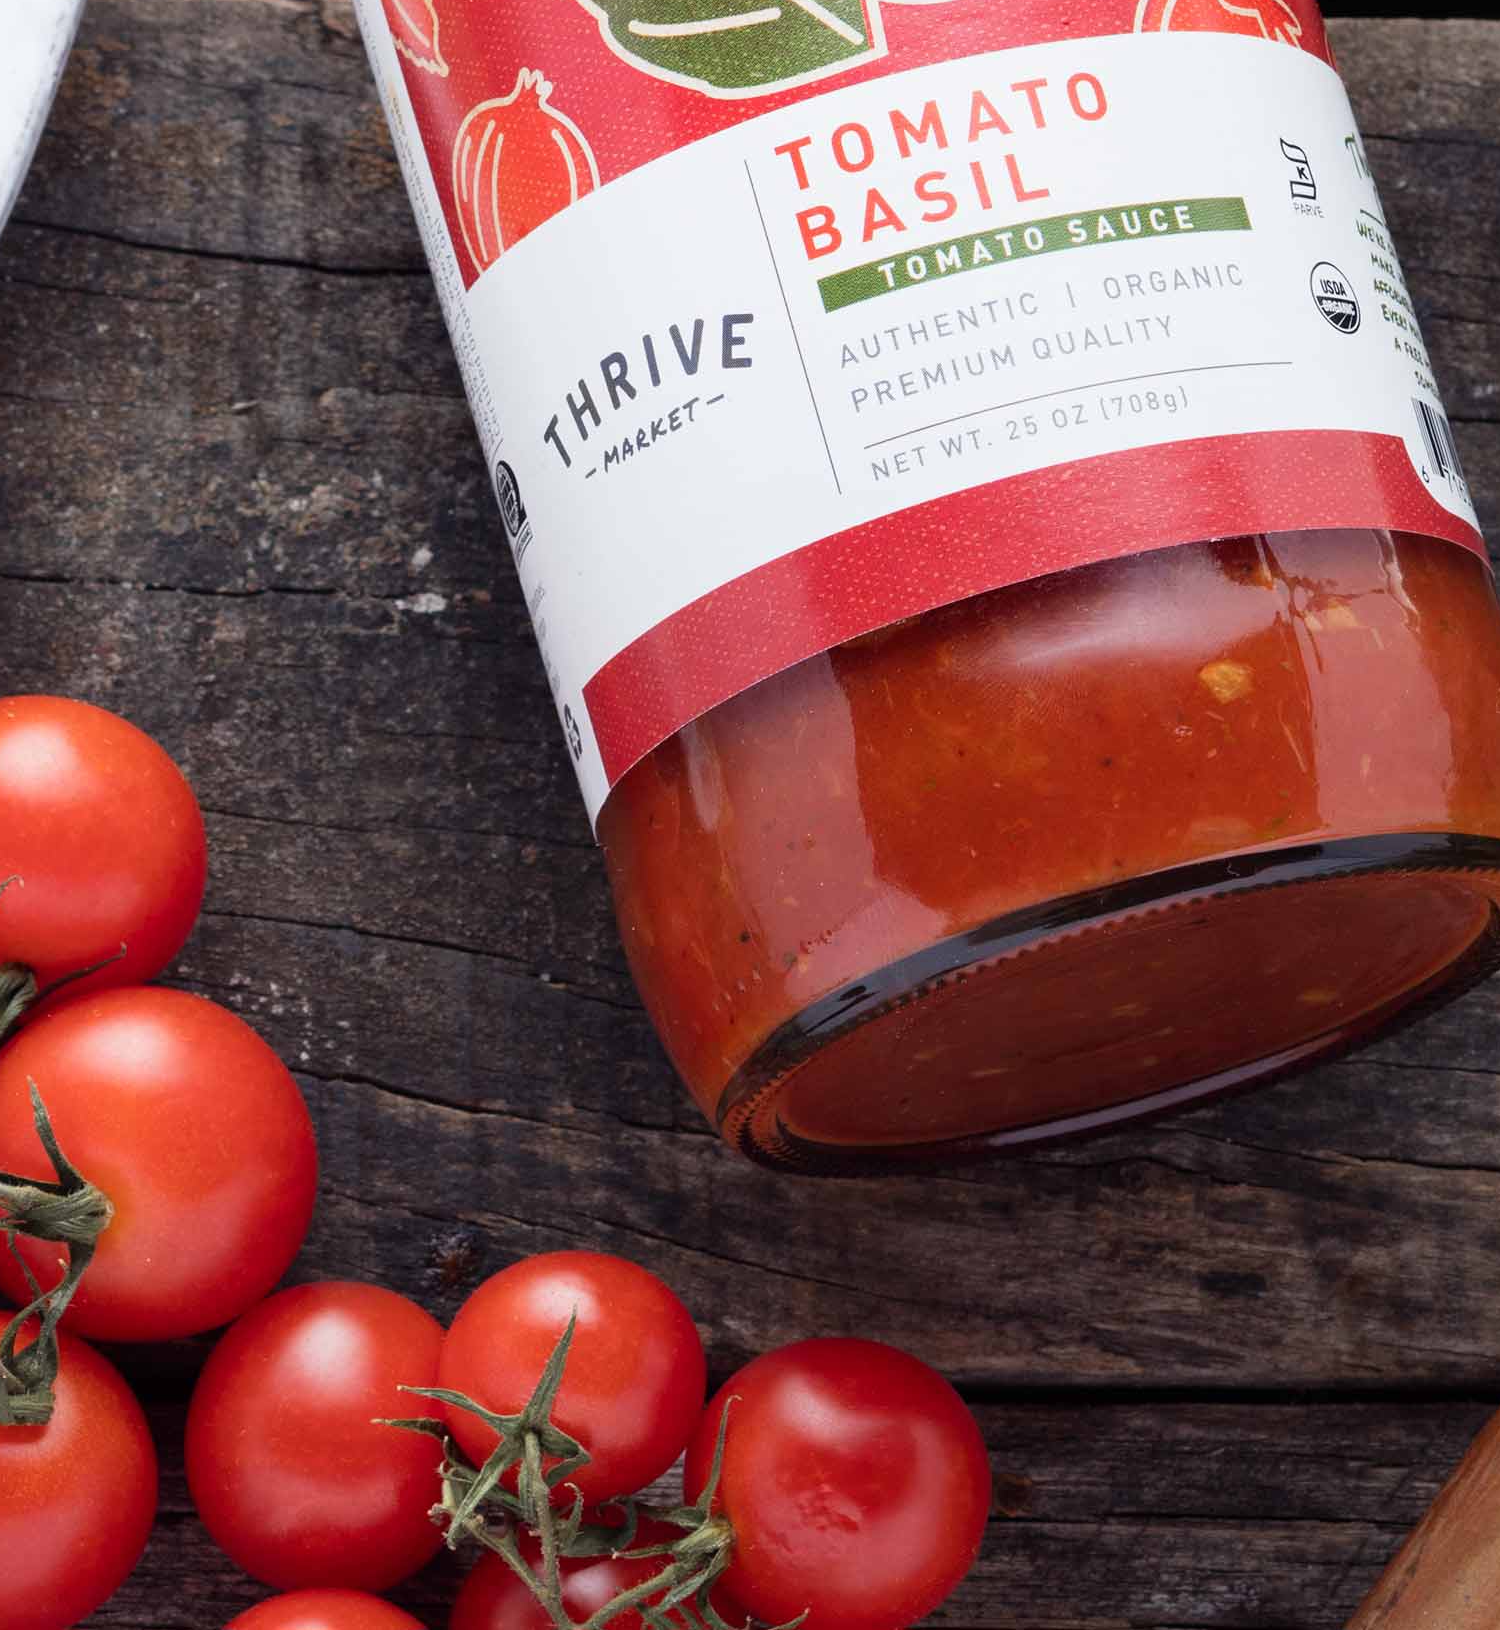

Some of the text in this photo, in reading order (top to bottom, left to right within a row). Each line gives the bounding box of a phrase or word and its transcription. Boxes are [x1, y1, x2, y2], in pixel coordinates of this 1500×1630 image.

[774, 72, 1109, 191] TOMATO
[796, 153, 1051, 261] BASIL
[878, 205, 1196, 289] TOMATO SAUCE
[1293, 201, 1325, 219] PARVE
[840, 263, 1244, 369] AUTHENTIC ORGANIC
[1320, 278, 1347, 297] USDA
[544, 313, 754, 468] THRIVE
[851, 315, 1173, 414] PREMIUM QUALITY
[871, 385, 1190, 482] NET WT. 25 OZ (708g)
